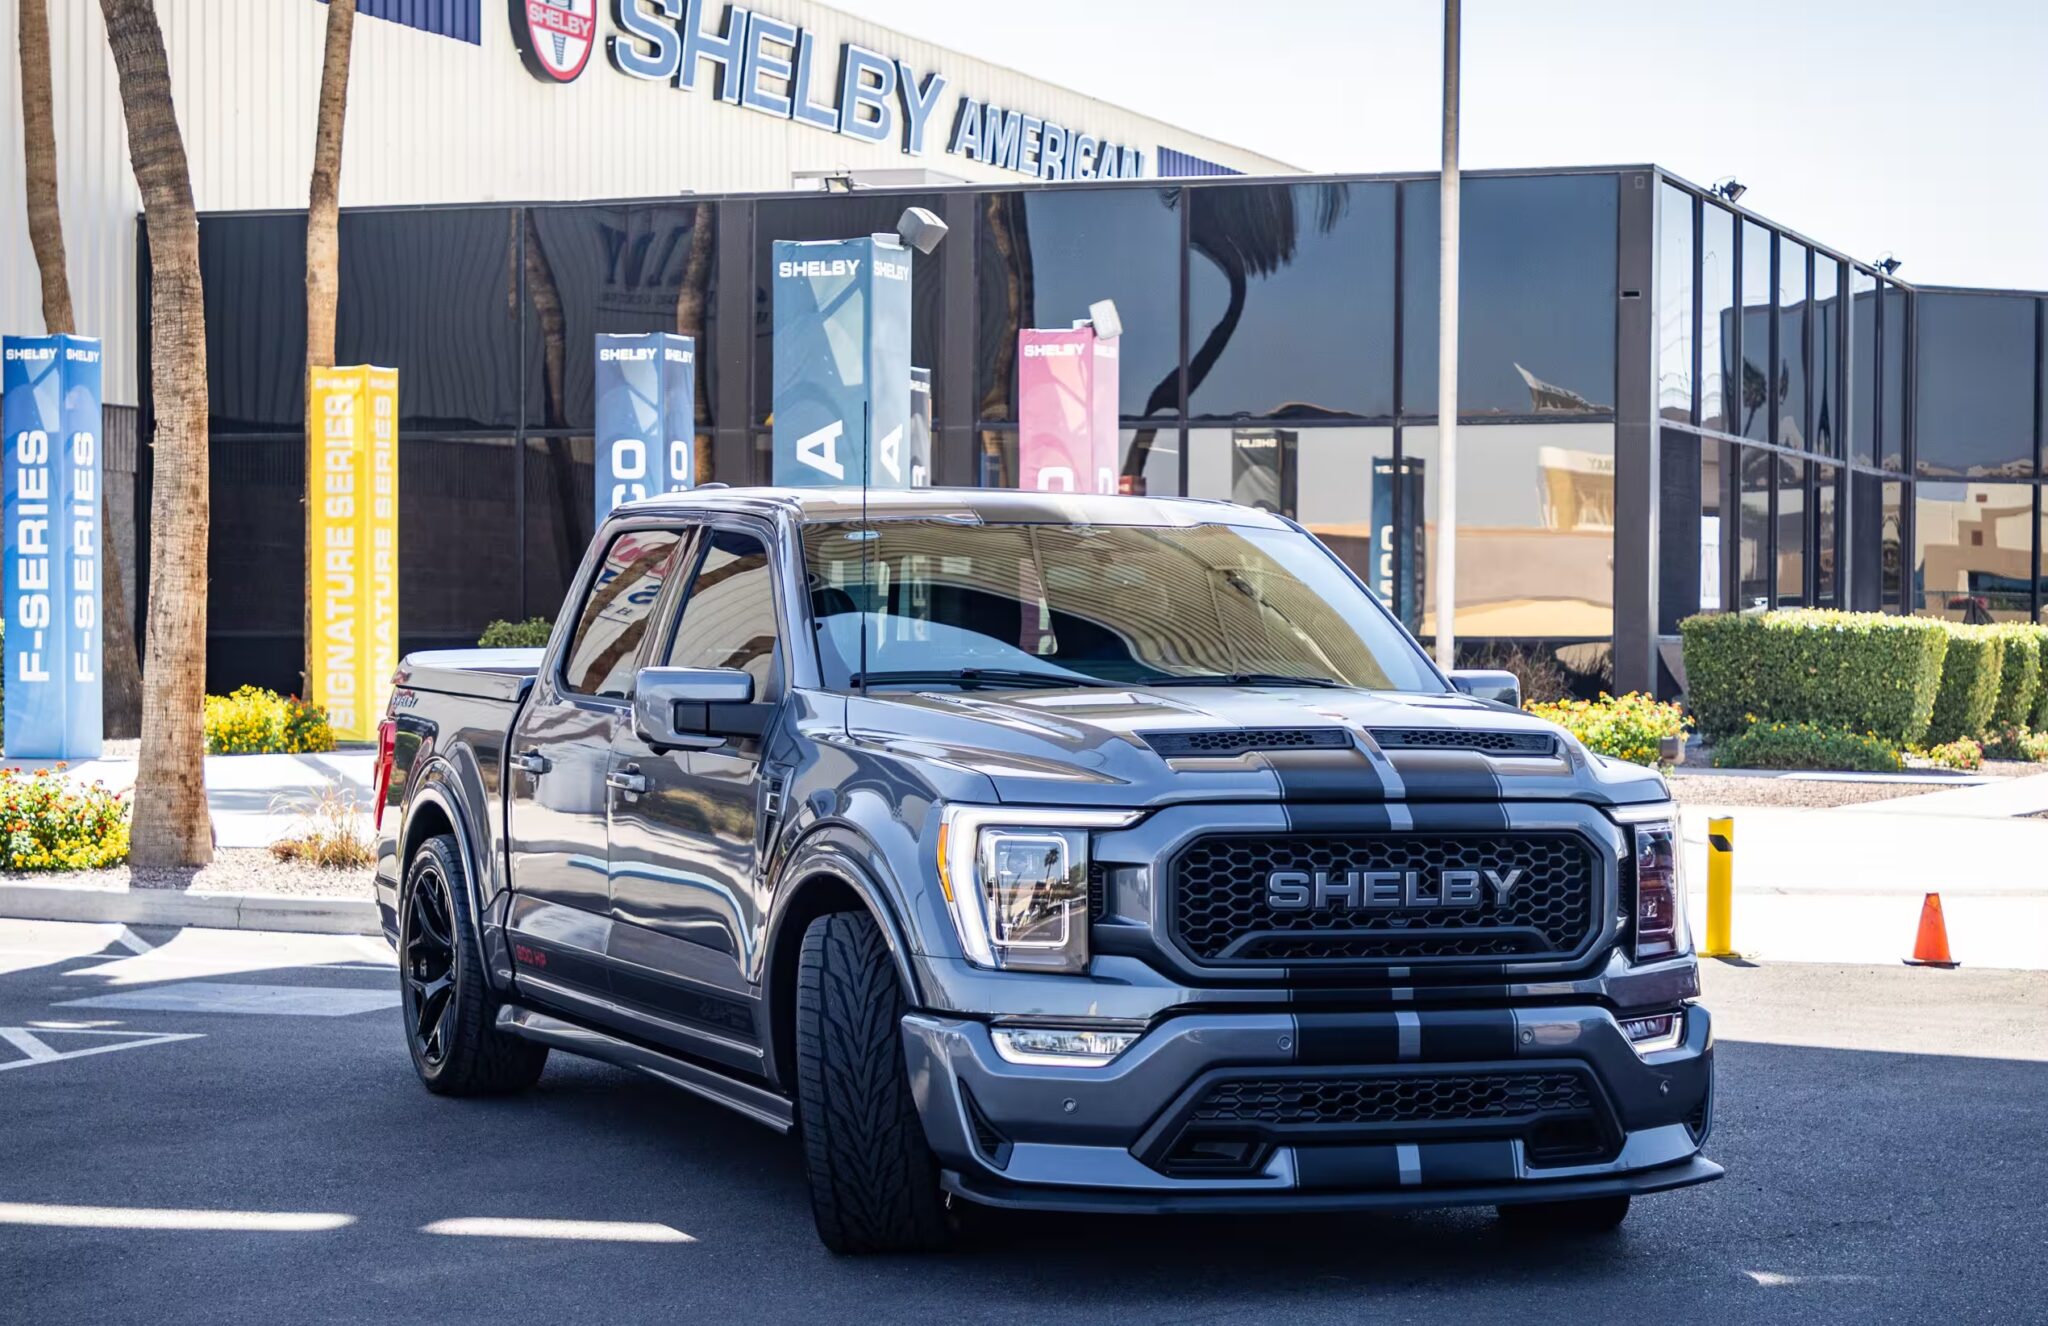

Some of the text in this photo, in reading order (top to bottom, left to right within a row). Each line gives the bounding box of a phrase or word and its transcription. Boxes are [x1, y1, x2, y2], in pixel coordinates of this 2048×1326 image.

[529, 3, 592, 37] SHELBY
[613, 0, 1147, 180] SHELBY AMERICAN
[778, 258, 861, 278] SHELBY
[873, 261, 910, 281] SHELBY
[5, 347, 58, 361] SHELBY
[66, 348, 100, 363] SHELBY
[600, 347, 658, 361] SHELBY
[1023, 343, 1085, 357] SHELBY
[374, 395, 392, 518] SERIES
[17, 430, 50, 682] F-SERIES
[73, 431, 95, 682] F-SERIES
[324, 394, 355, 729] SIGNATURE SERIES
[1267, 870, 1525, 910] SHELBY
